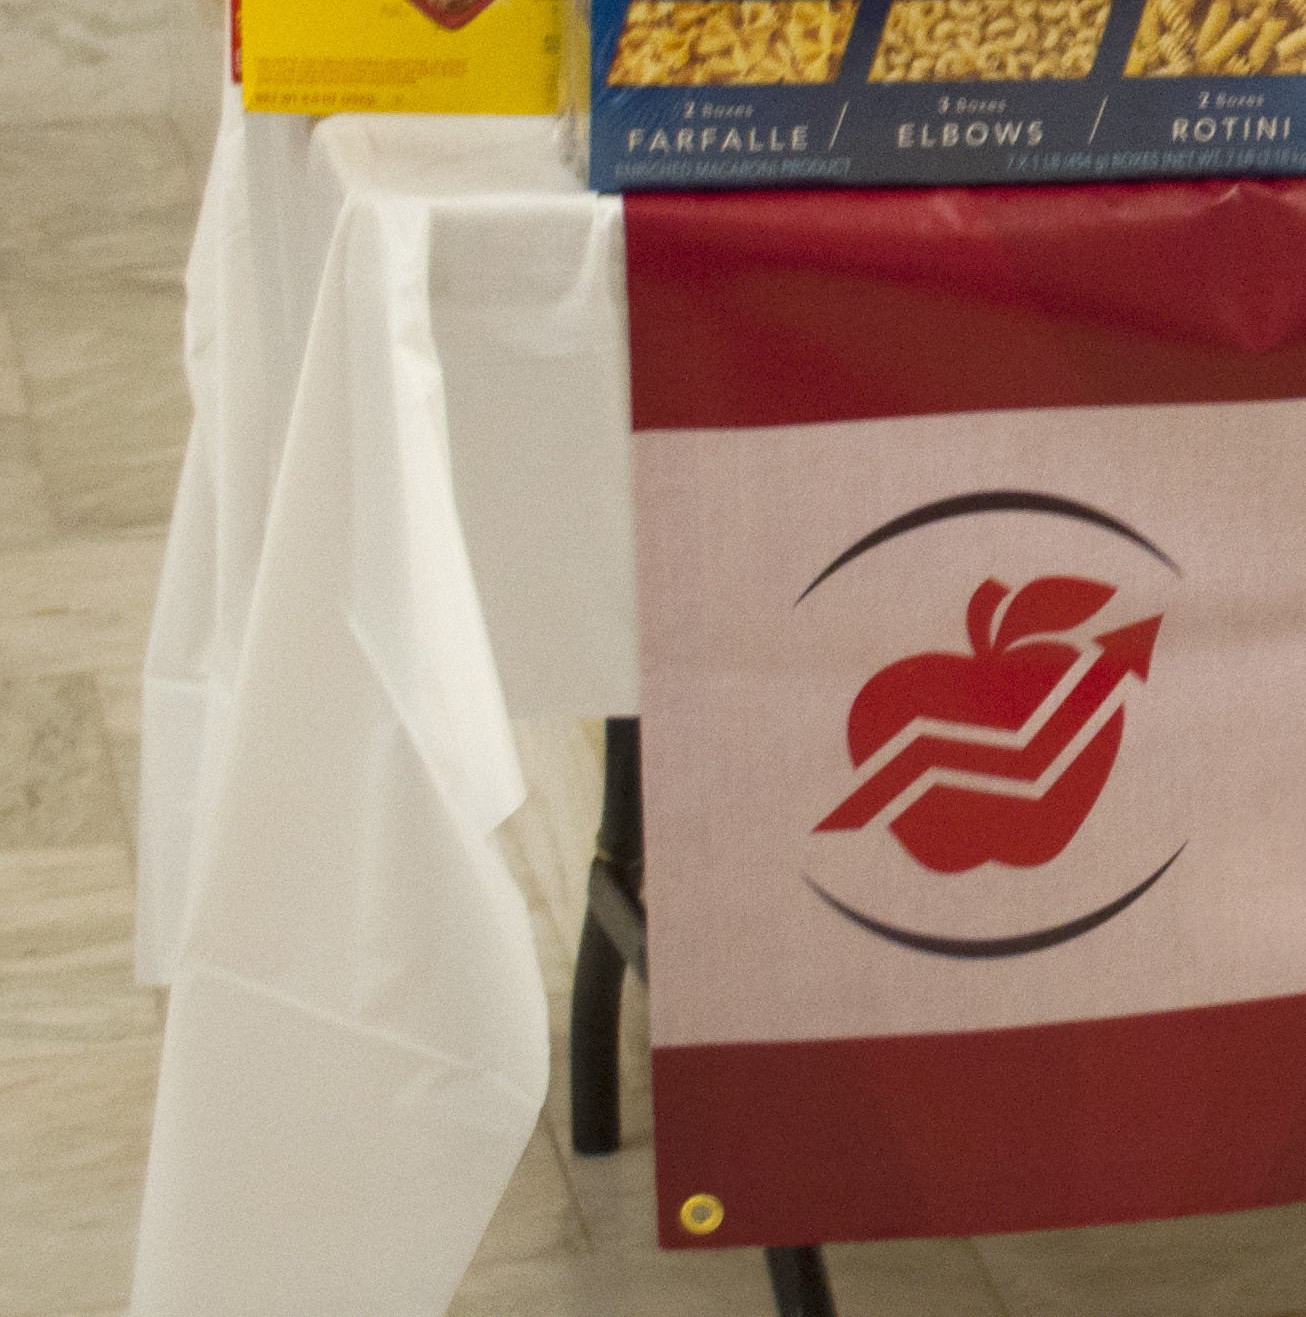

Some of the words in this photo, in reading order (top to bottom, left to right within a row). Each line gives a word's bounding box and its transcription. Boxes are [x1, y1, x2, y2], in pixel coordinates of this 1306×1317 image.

[683, 100, 696, 120] 2
[1198, 91, 1210, 109] 2
[627, 125, 809, 153] FARFALLE
[897, 119, 1045, 149] ELBOWS
[1171, 116, 1293, 143] ROTINI
